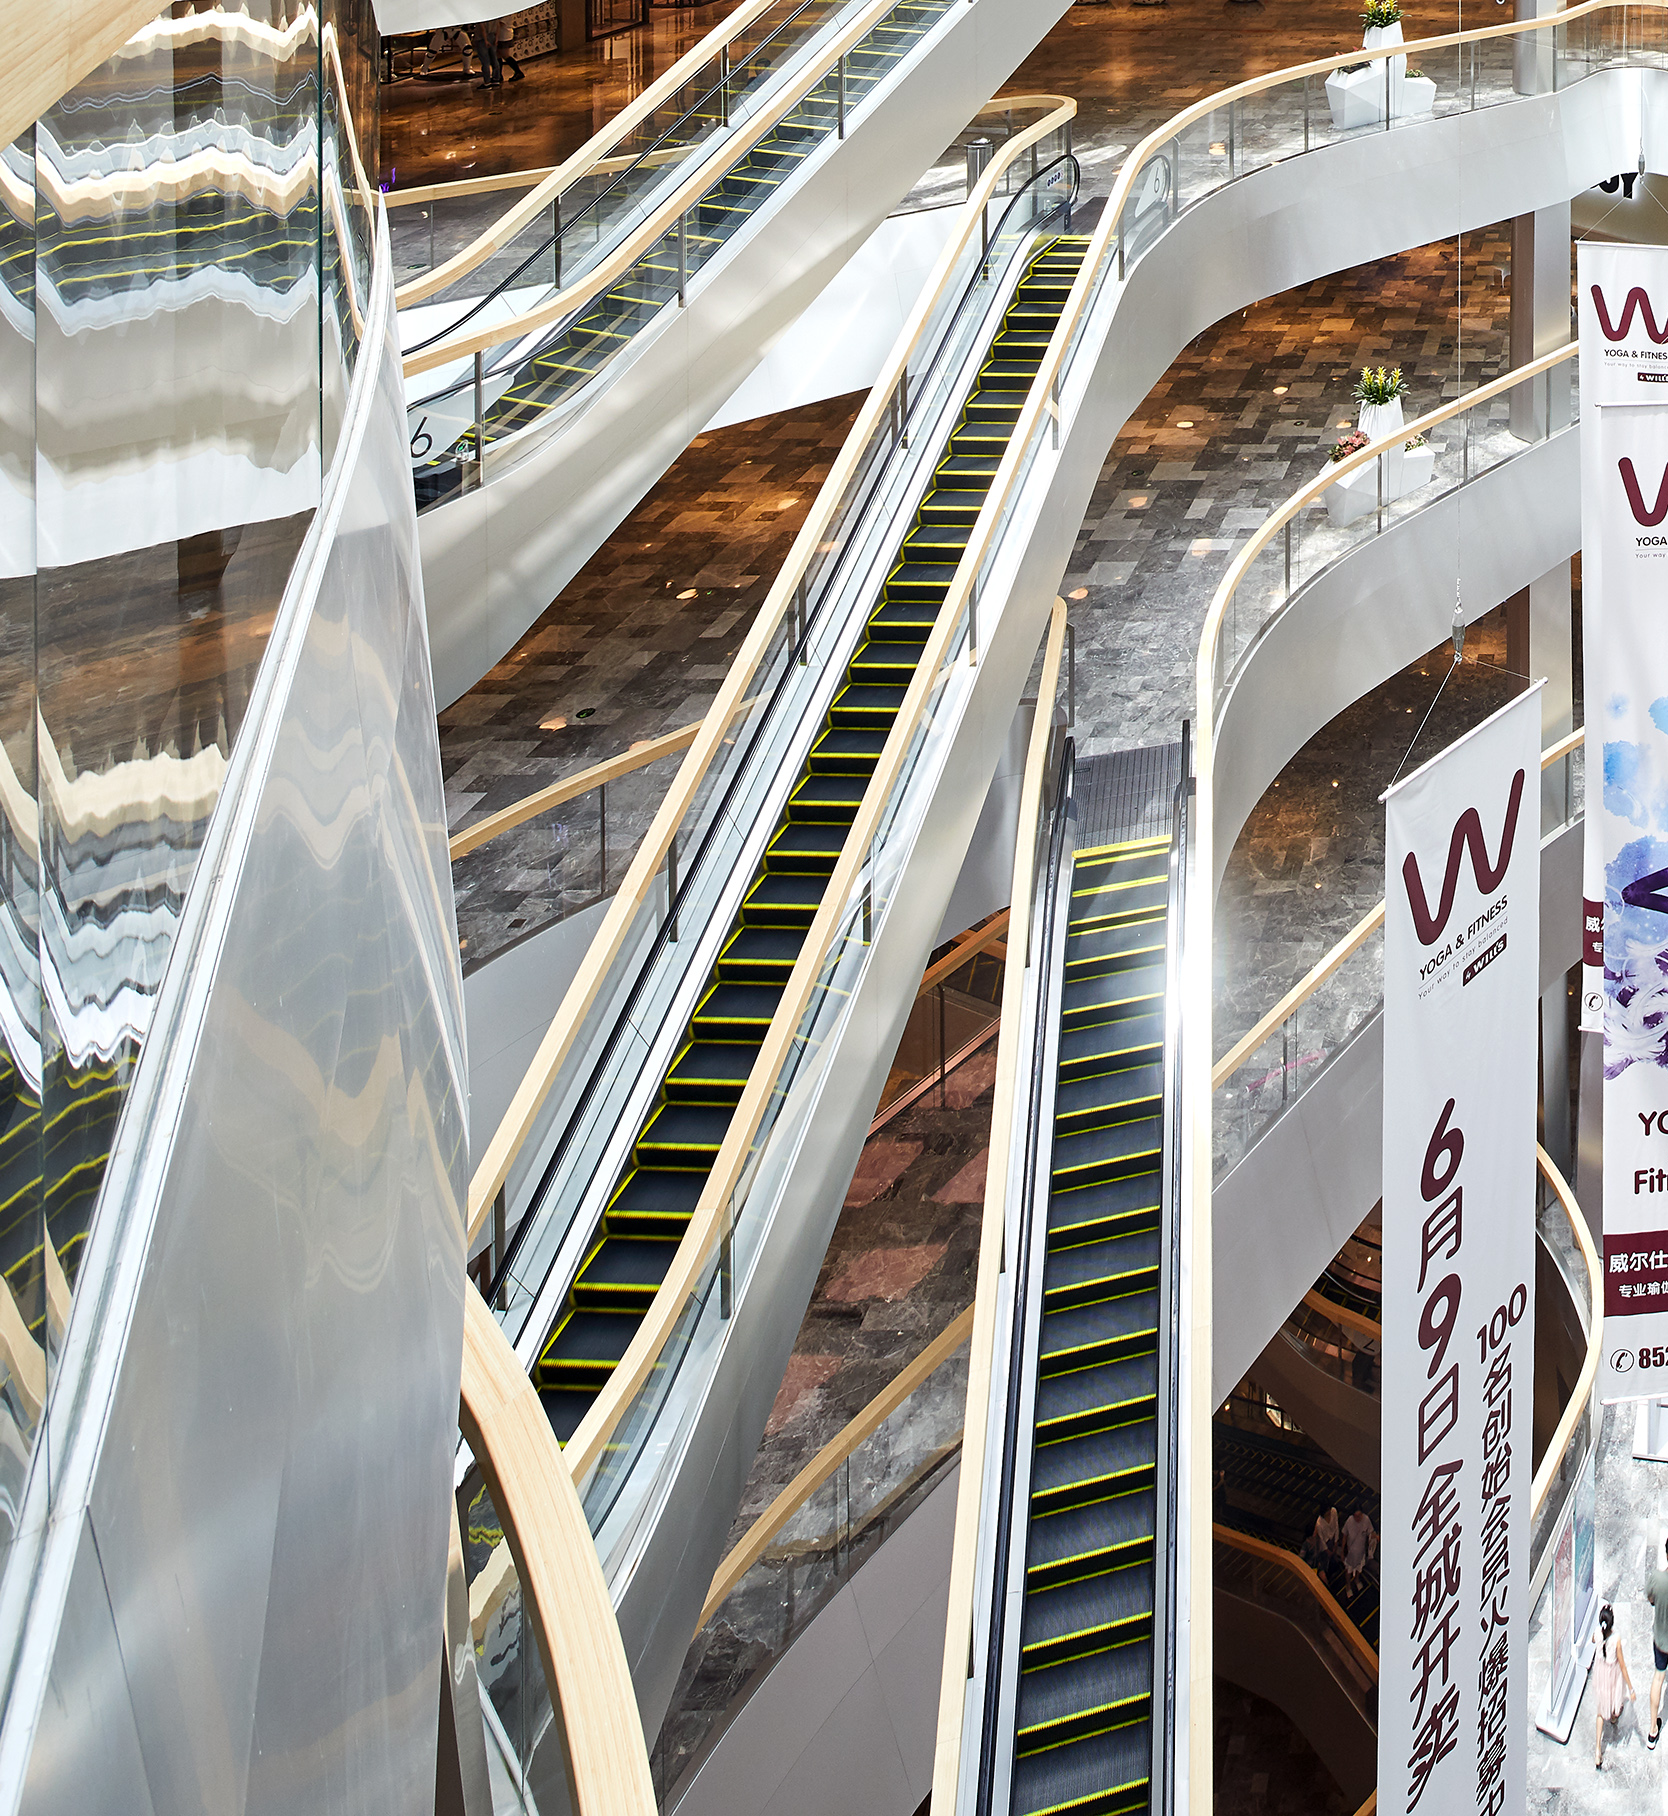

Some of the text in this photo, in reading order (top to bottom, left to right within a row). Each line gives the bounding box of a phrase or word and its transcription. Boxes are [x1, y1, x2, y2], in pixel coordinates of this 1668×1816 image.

[1604, 349, 1629, 357] YOGA
[1631, 350, 1638, 358] &
[410, 416, 433, 459] 6
[1636, 536, 1668, 546] YOGA
[1402, 768, 1525, 946] W
[1418, 917, 1509, 1000] Your way to stay balanced
[1419, 894, 1508, 981] YOGA & FITNESS
[1406, 1096, 1465, 1815] 6月9日全城开卖
